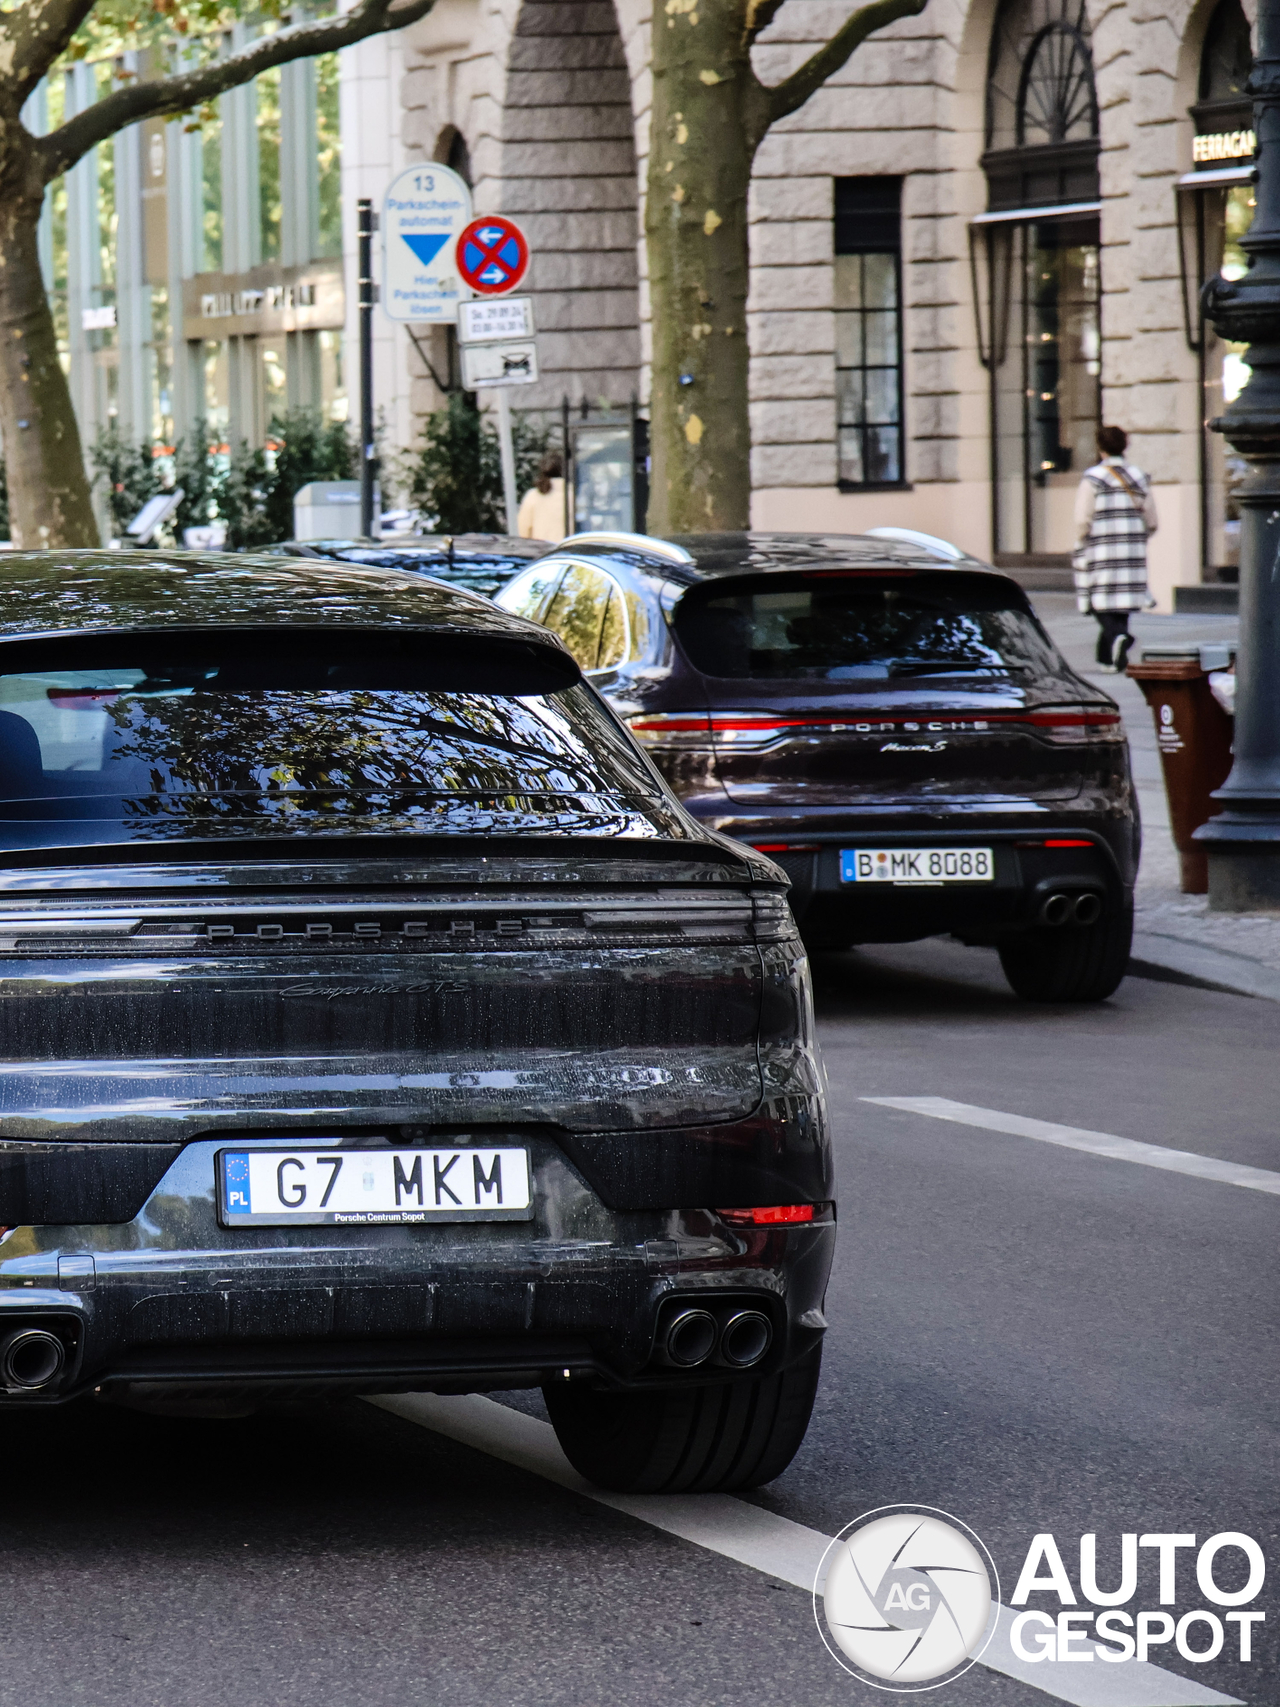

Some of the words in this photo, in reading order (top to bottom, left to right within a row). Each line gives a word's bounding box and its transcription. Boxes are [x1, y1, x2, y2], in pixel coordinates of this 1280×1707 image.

[413, 175, 436, 192] 13
[387, 198, 464, 211] Parkschein-
[399, 216, 453, 227] automat
[831, 721, 988, 732] PORSCHE
[880, 742, 931, 752] Macan
[858, 853, 873, 877] B
[891, 853, 922, 876] MK
[929, 852, 988, 876] 8088
[207, 920, 522, 941] PORSCHE
[279, 982, 402, 1000] Cayenne
[230, 1191, 249, 1206] PL
[277, 1157, 343, 1208] G7
[393, 1154, 504, 1206] MKM
[334, 1212, 367, 1222] Porsche
[367, 1212, 401, 1222] Centrum
[401, 1212, 425, 1223] Sopot
